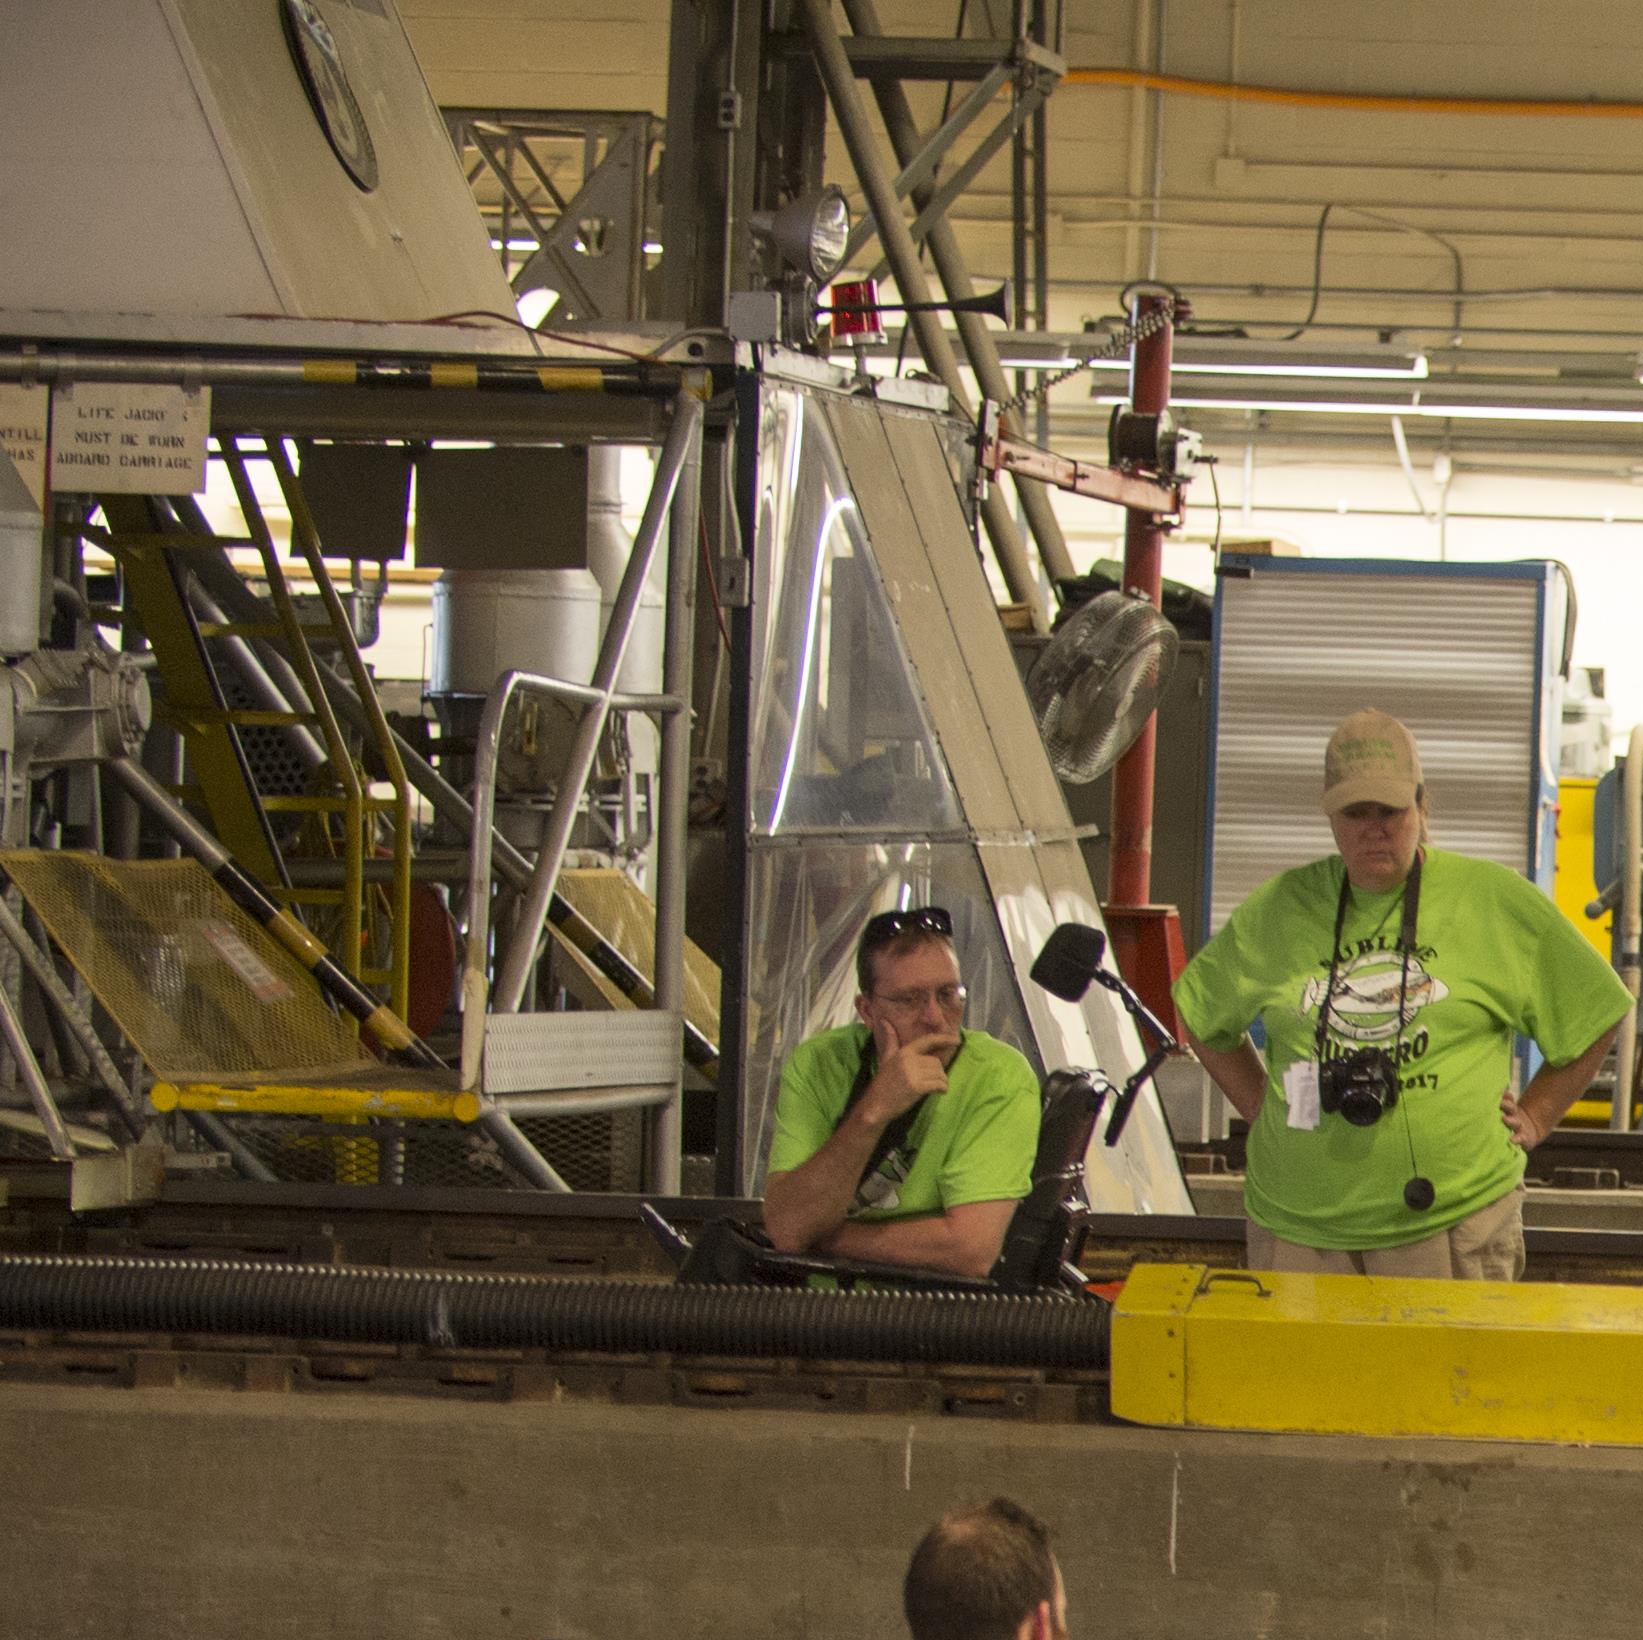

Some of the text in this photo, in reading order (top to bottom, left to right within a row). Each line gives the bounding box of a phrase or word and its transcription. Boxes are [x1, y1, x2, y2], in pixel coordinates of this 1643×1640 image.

[78, 407, 188, 423] LIFE JACKES
[75, 431, 185, 448] MUST BE WORN
[56, 452, 192, 470] ABOARD CARRIAGE
